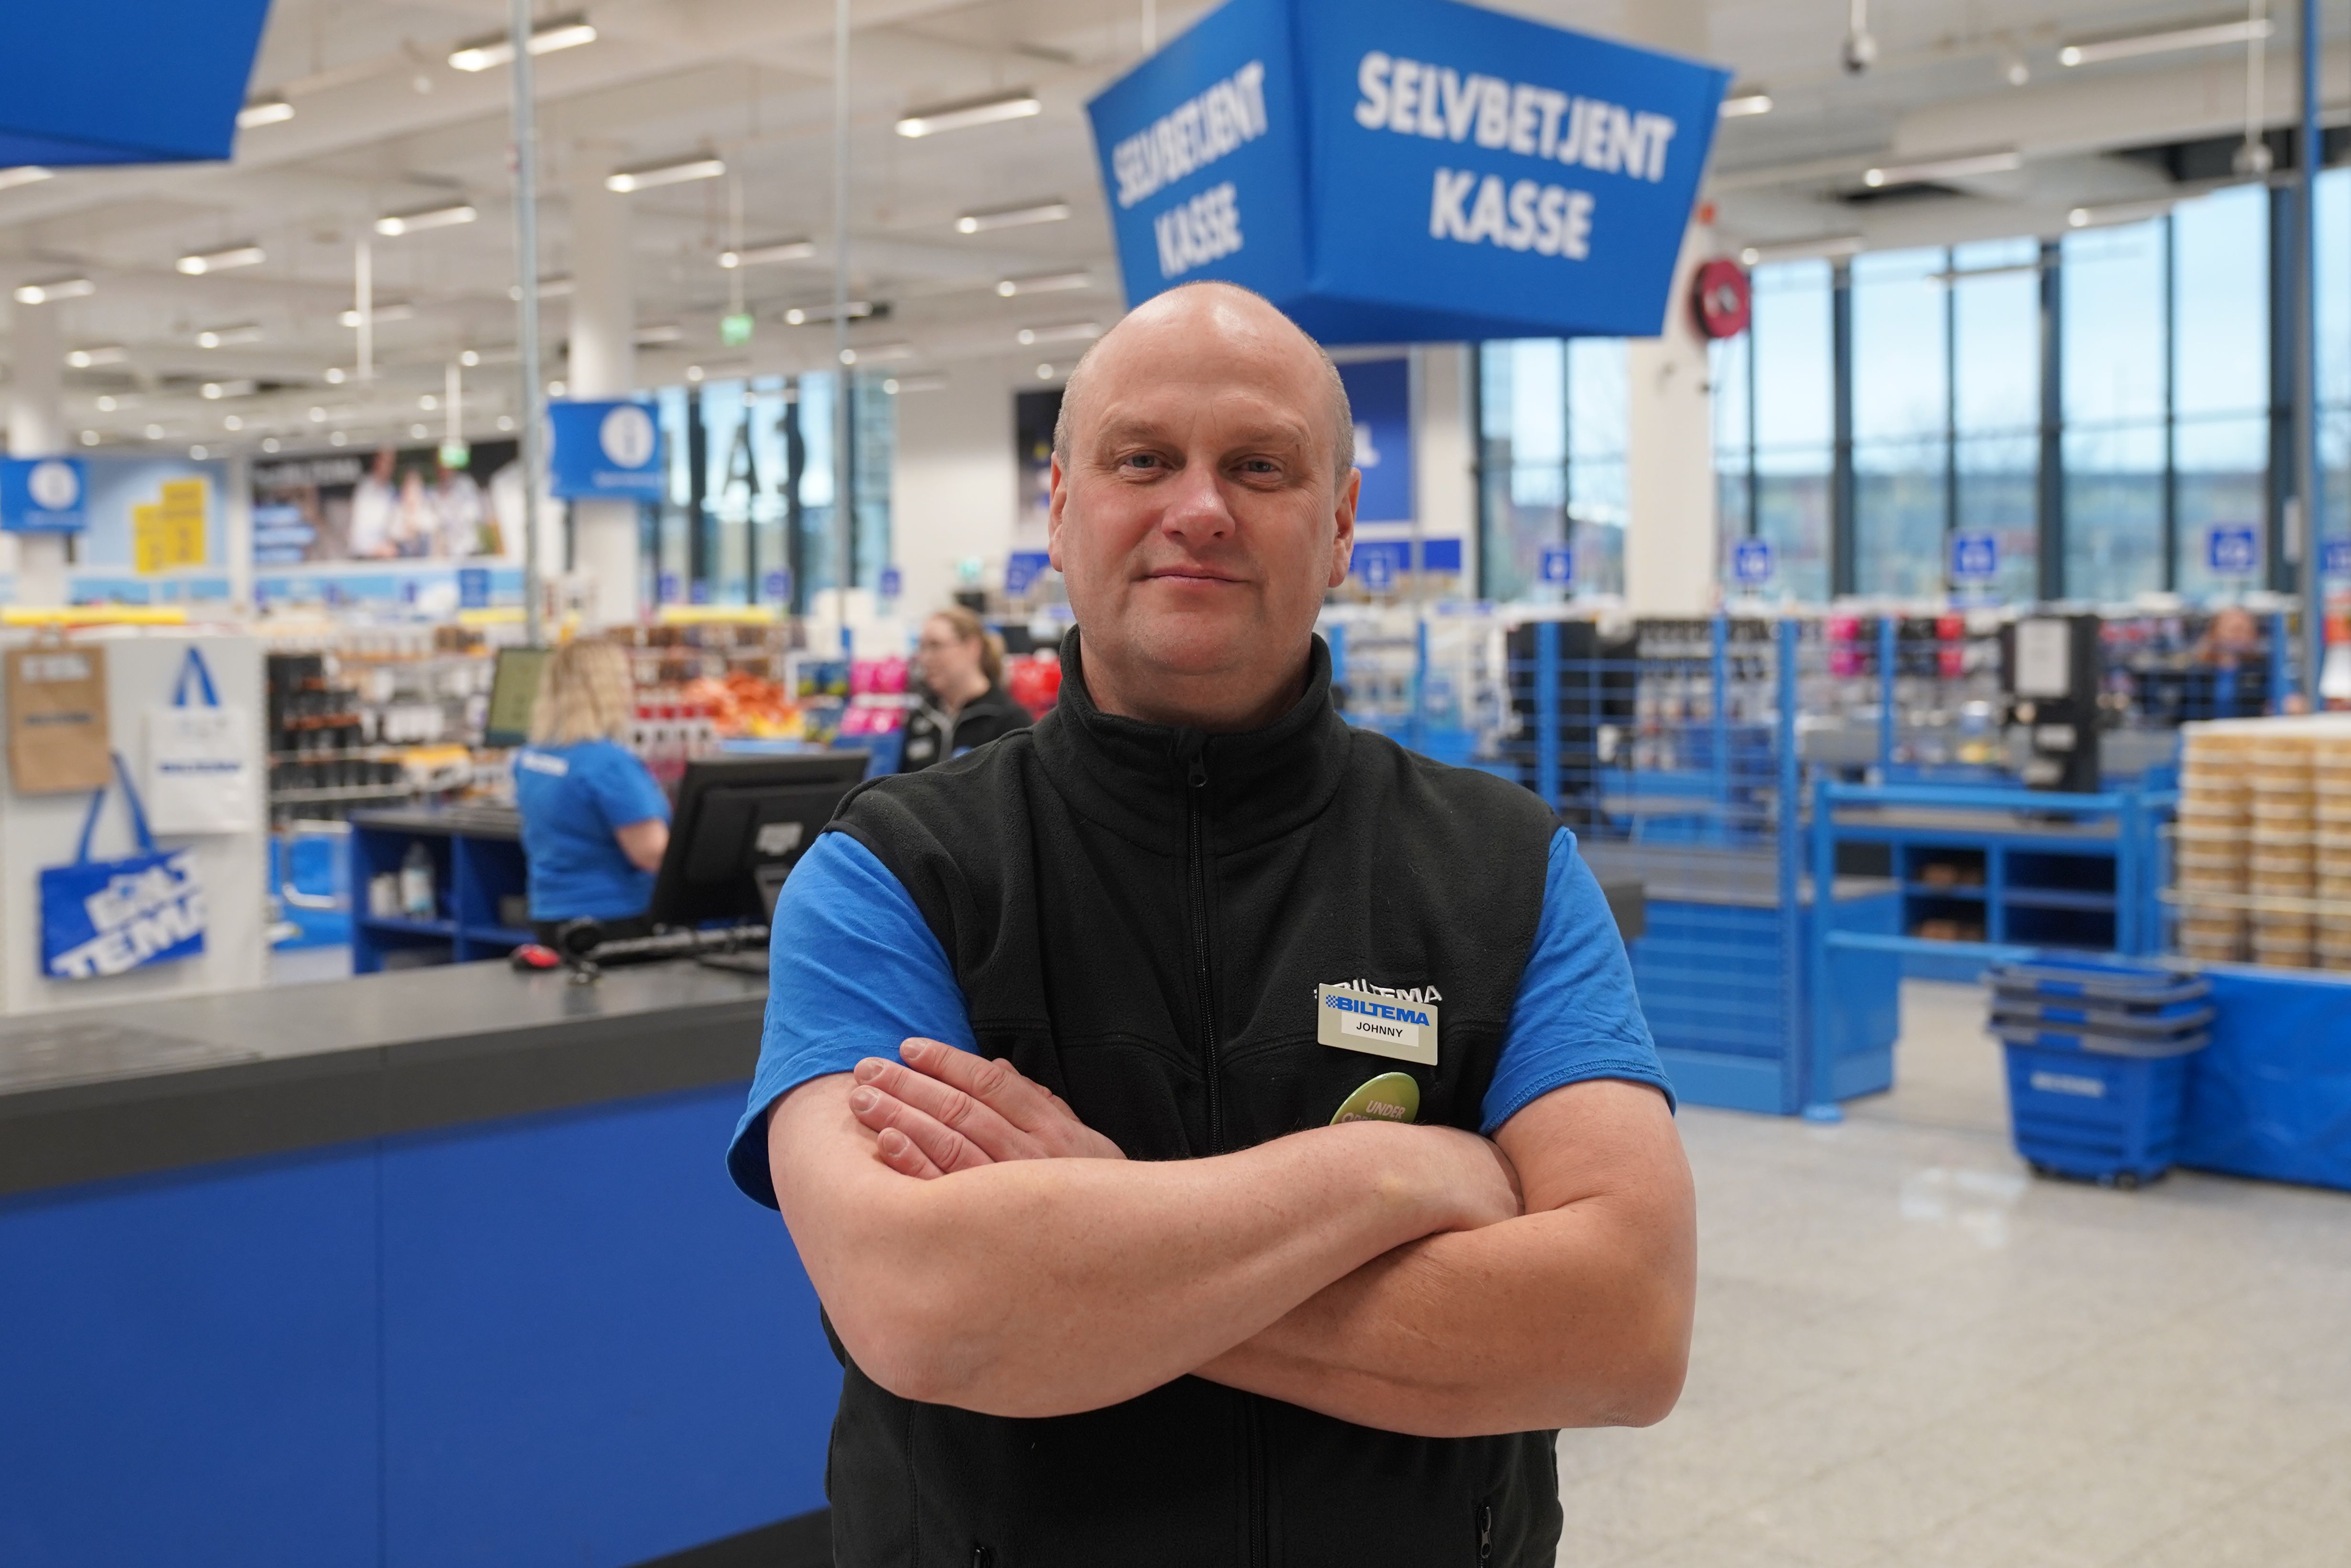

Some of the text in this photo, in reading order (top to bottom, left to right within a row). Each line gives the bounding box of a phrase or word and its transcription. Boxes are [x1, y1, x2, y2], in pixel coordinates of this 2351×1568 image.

[1112, 59, 1268, 209] SELVBETJENT
[1354, 51, 1676, 183] SELVBETJENT
[1154, 181, 1244, 279] KASSE
[1429, 167, 1595, 261] KASSE
[1337, 996, 1430, 1026] BILTEMA
[1356, 1022, 1403, 1037] JOHNNY
[1365, 1100, 1406, 1119] UNDER
